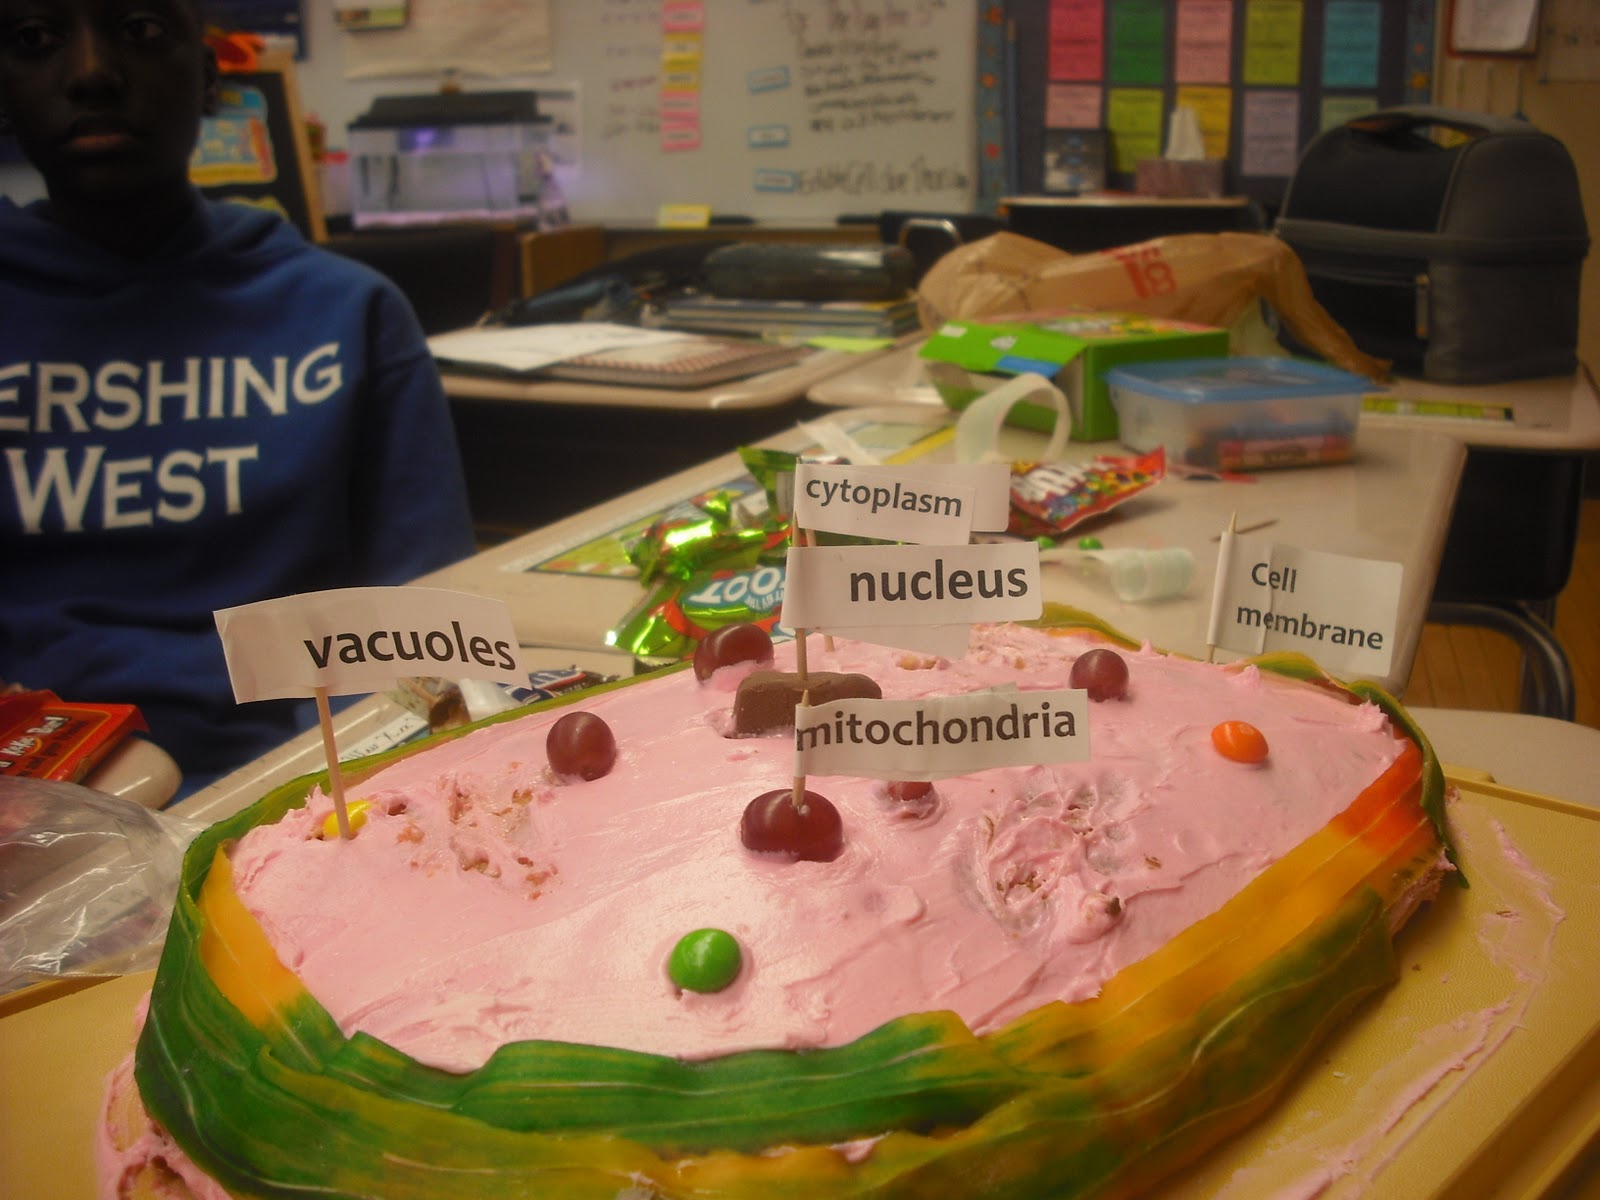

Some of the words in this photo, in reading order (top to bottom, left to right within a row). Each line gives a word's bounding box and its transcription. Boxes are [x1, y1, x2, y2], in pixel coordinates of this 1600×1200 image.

[0, 342, 343, 433] ERSHING
[805, 475, 963, 517] cytoplasm
[687, 567, 785, 604] OOT
[850, 558, 1029, 602] nucleus
[1251, 562, 1298, 593] Cell
[303, 620, 517, 671] vacuoles
[1236, 605, 1384, 650] membrane
[796, 702, 1077, 752] mitochondria
